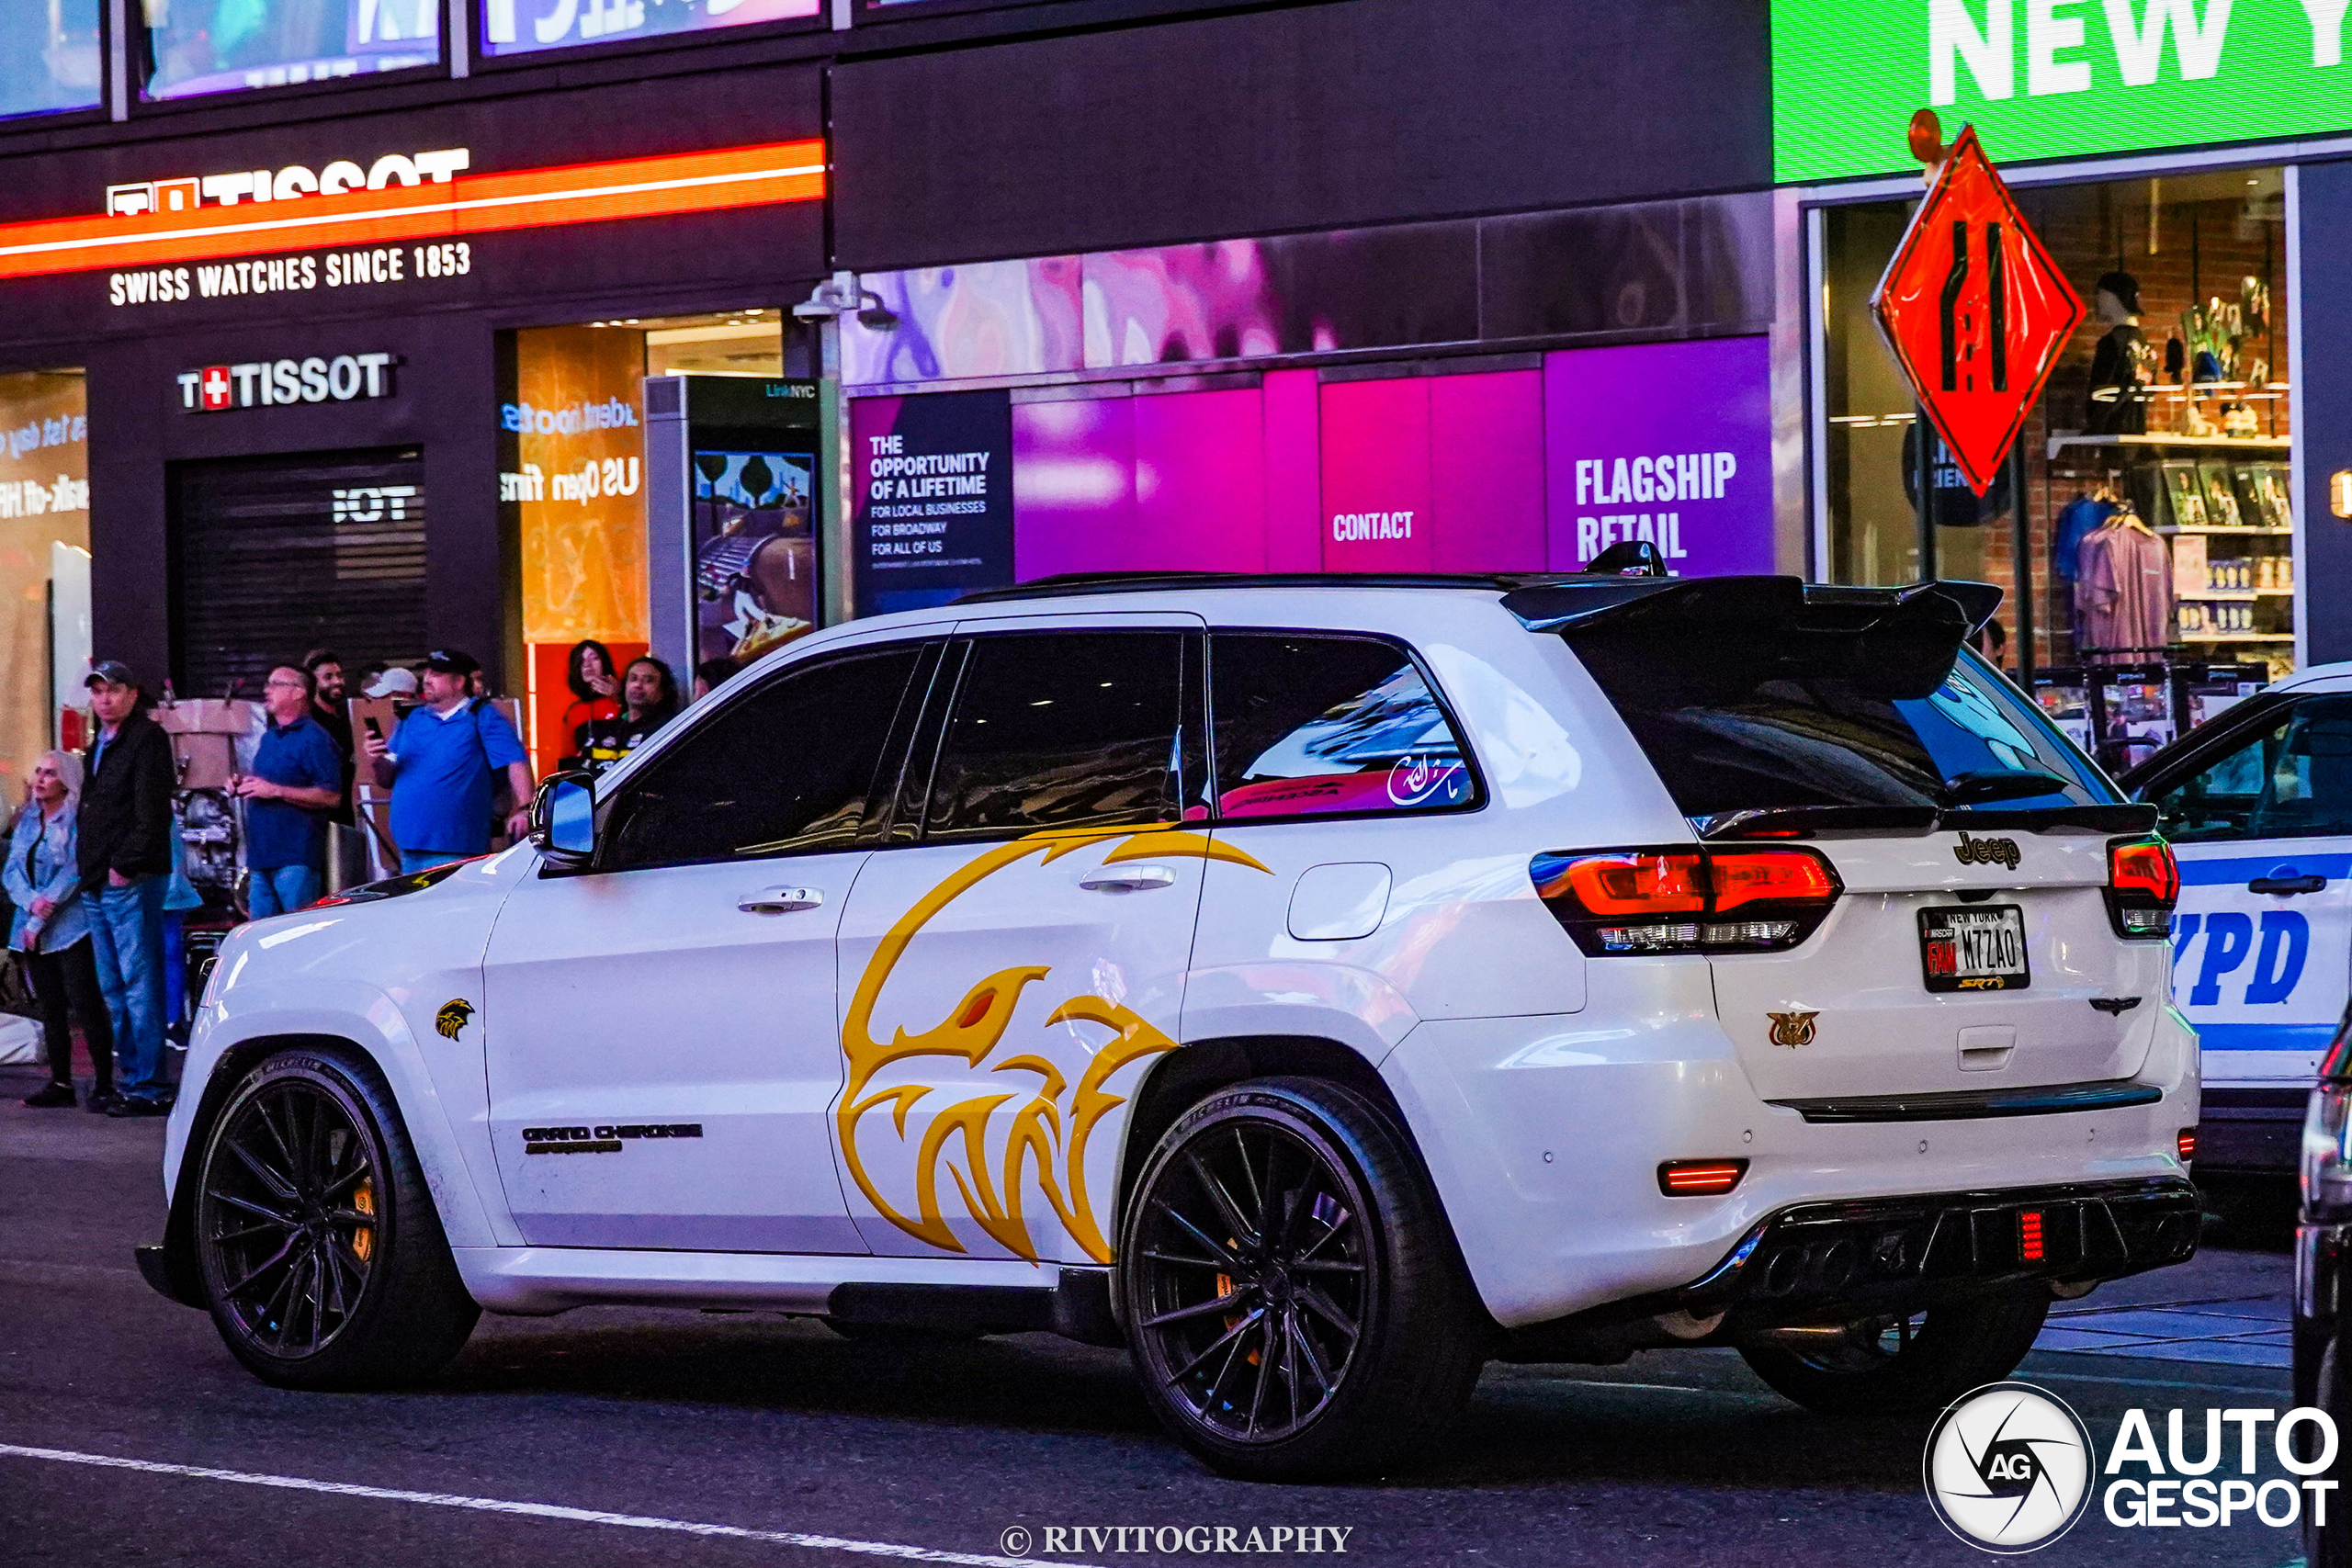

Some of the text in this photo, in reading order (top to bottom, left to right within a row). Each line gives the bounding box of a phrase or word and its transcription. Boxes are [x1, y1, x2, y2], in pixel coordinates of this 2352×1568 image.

[1929, 0, 2233, 107] NEW
[109, 242, 470, 306] SWISS WATCHES SINCE 1853
[232, 353, 390, 407] TISSOT
[765, 384, 816, 399] LinkNYC
[869, 434, 903, 456] THE
[870, 451, 989, 478] OPPORTUNITY
[1576, 452, 1736, 505] FLAGSHIP
[870, 474, 987, 500] OF A LIFETIME
[871, 501, 987, 518] FOR LOCAL BUSINESSES
[871, 522, 947, 536] FOR BROADWAY
[1332, 511, 1414, 542] CONTACT
[1577, 513, 1688, 562] RETAIL
[872, 540, 943, 555] FOR ALL OF US
[1953, 830, 2022, 871] Jeep
[1950, 912, 1998, 924] NEW YORK
[1930, 929, 1954, 938] NASCAR
[1928, 942, 1957, 974] FAN
[2171, 910, 2310, 1006] YPD
